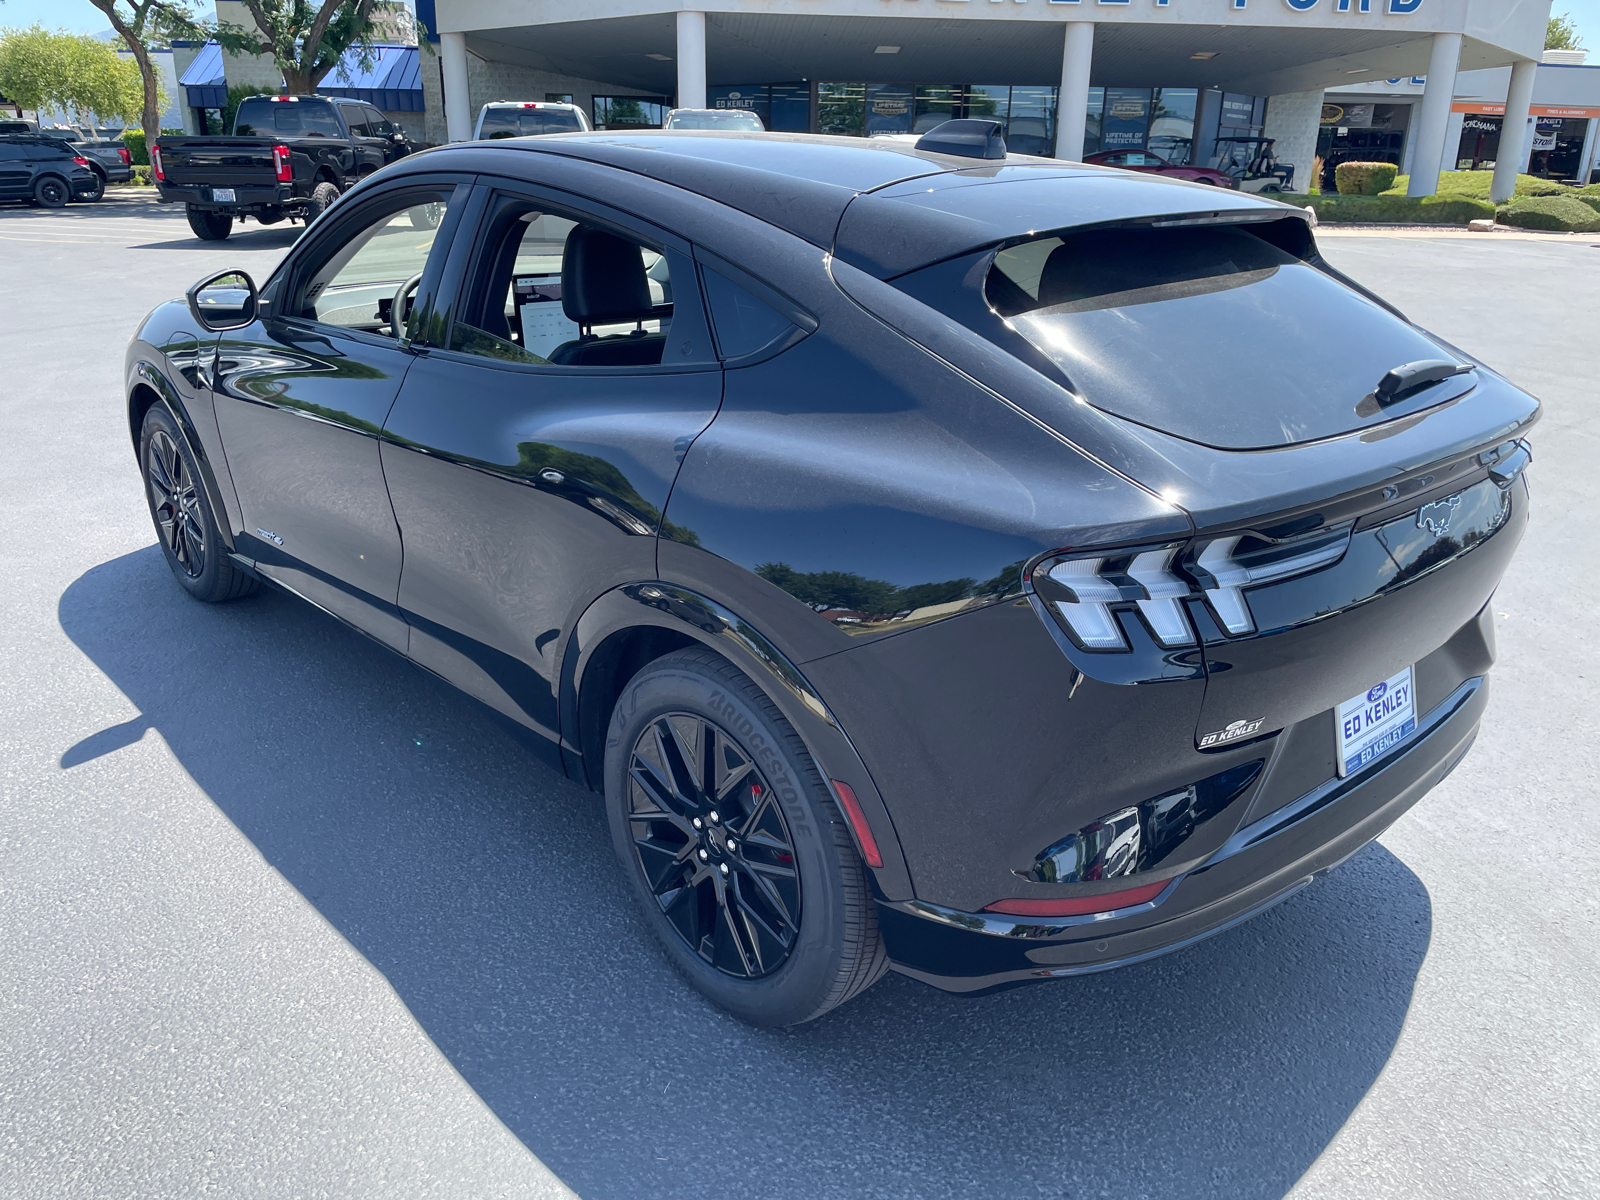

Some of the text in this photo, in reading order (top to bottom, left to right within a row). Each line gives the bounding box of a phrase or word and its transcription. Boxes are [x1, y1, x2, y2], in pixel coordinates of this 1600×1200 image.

[716, 99, 754, 108] ED KENLEY
[1344, 714, 1361, 740] ED
[1365, 683, 1409, 727] KENLEY
[1201, 720, 1263, 746] ED KENLEY
[1360, 748, 1372, 764] ED
[1373, 726, 1403, 756] KENLEY
[707, 688, 813, 838] BRIDGESTONE
